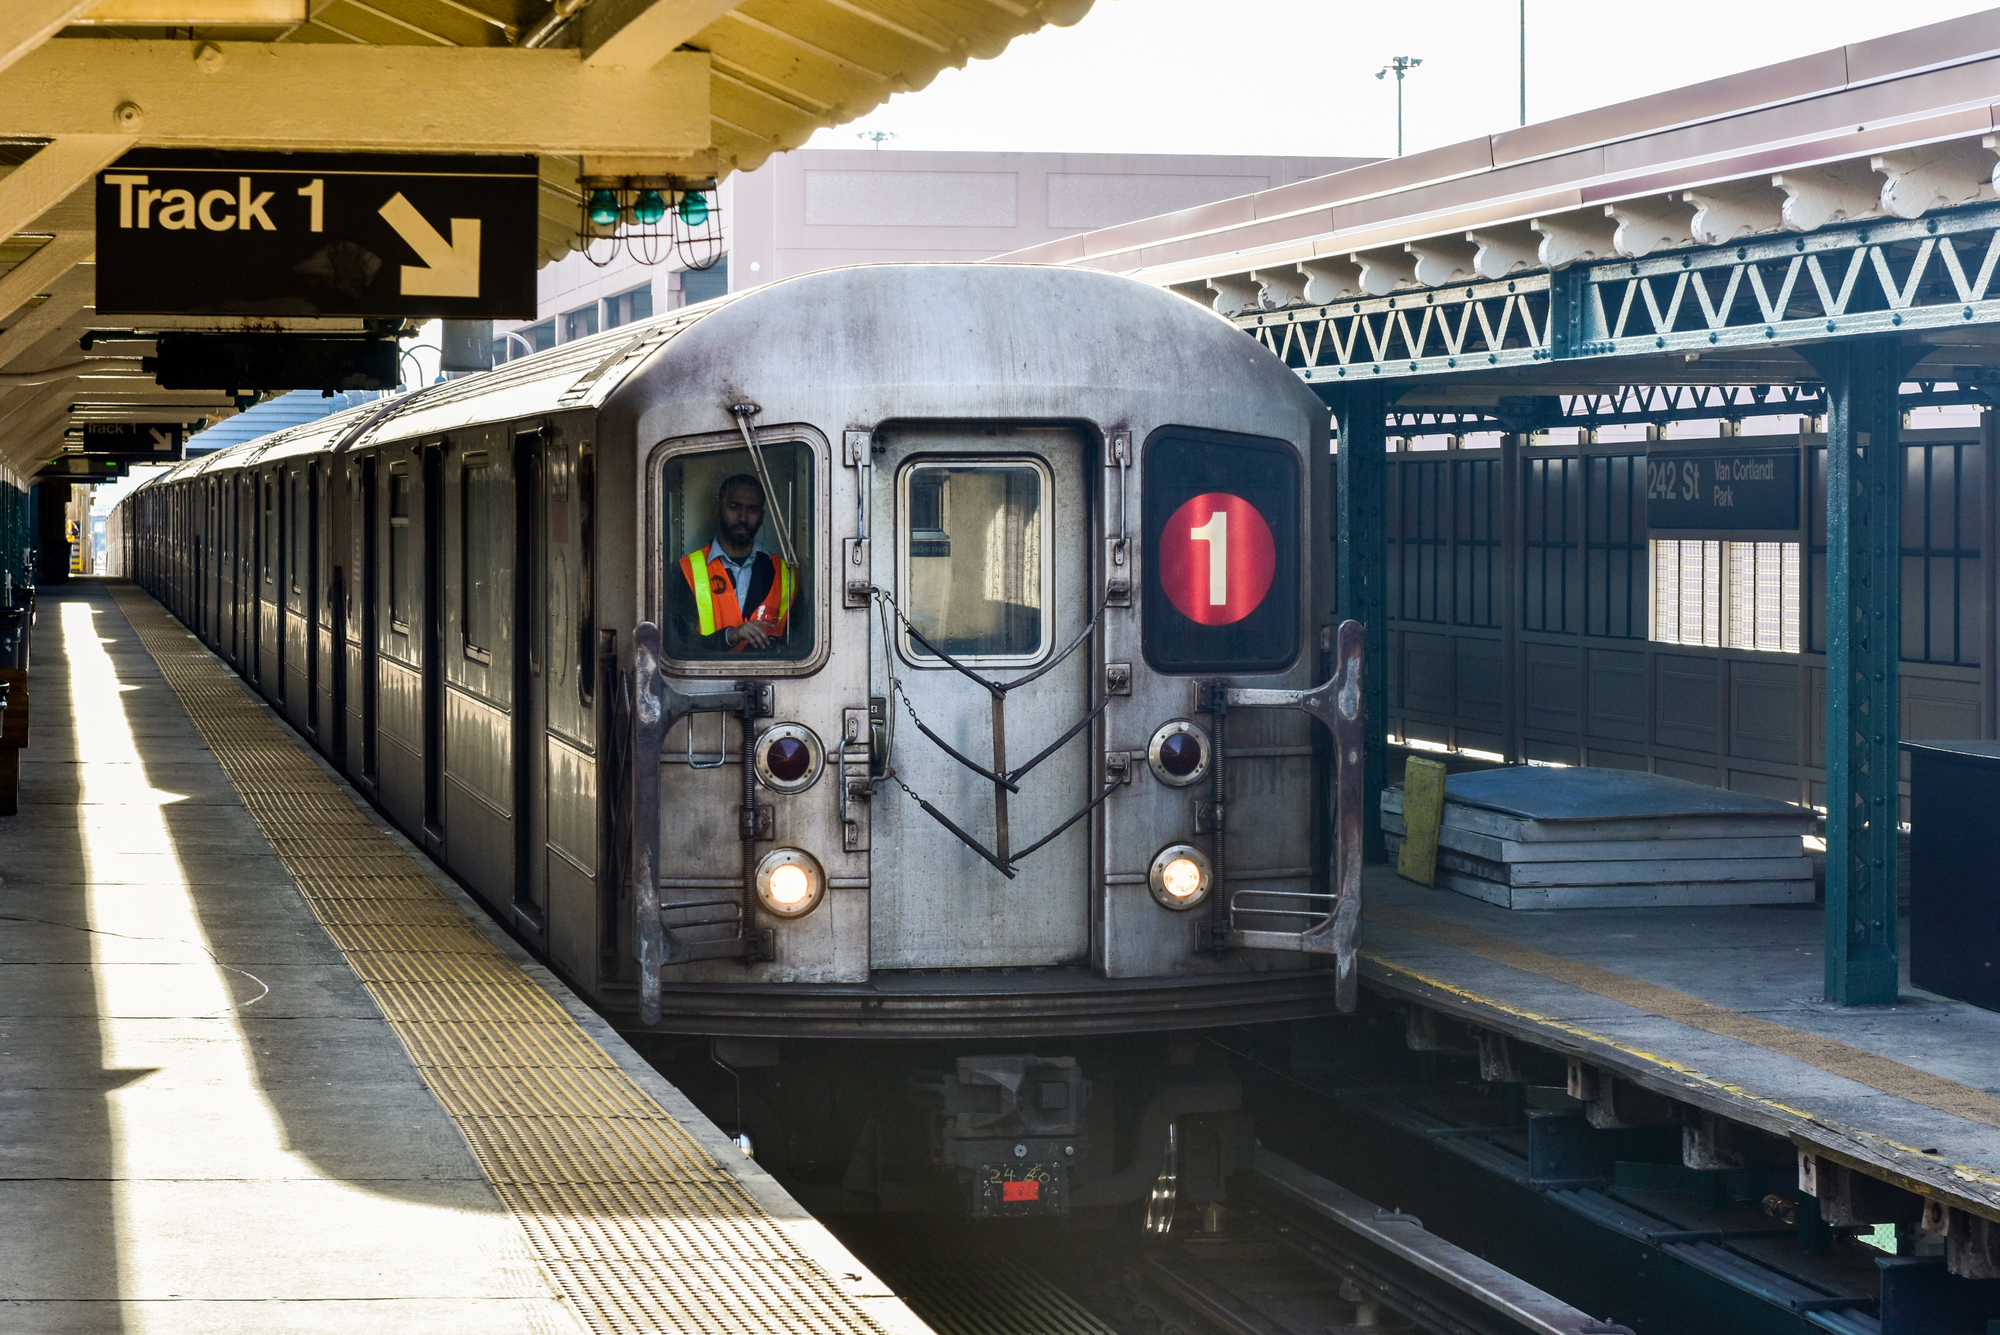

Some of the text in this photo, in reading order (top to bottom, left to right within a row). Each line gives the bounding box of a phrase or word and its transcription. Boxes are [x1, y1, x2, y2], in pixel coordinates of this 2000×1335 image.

[104, 174, 324, 232] Track 1
[1648, 460, 1700, 500] 242 St
[1714, 458, 1774, 480] Van Cortlandt
[1714, 485, 1733, 507] Park
[1190, 511, 1227, 605] 1
